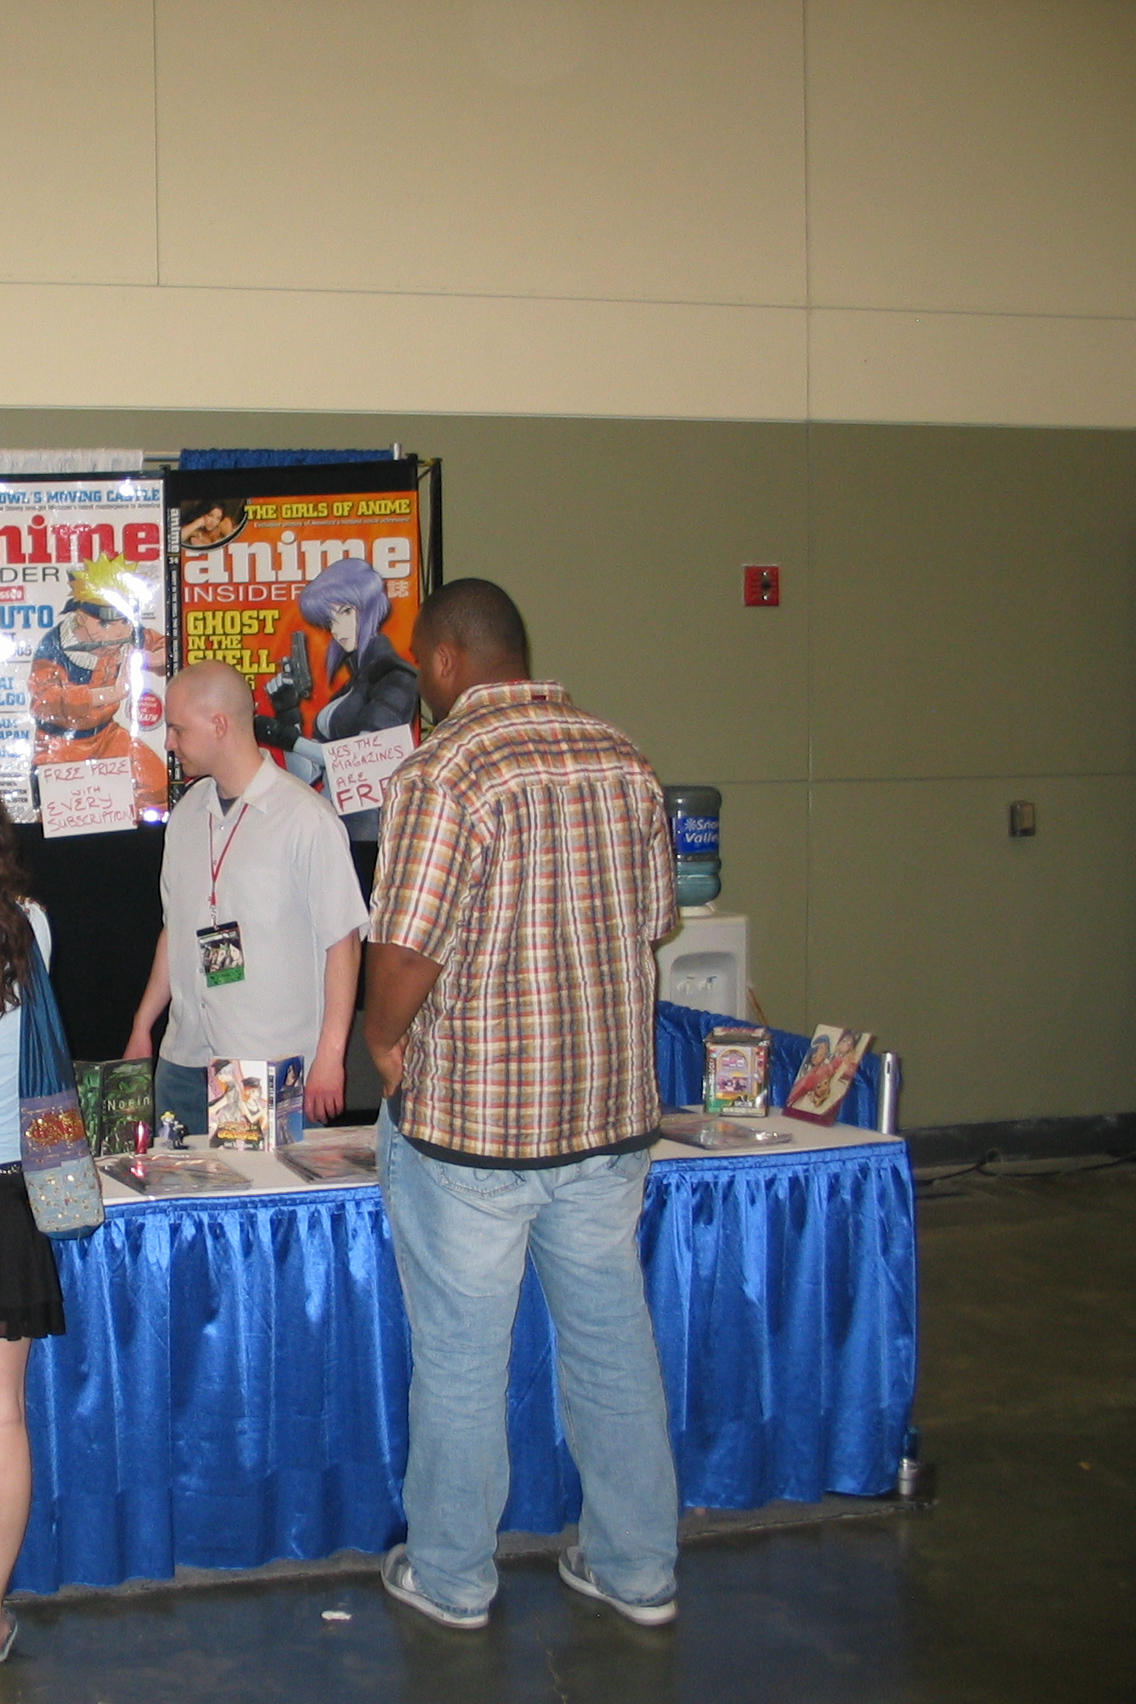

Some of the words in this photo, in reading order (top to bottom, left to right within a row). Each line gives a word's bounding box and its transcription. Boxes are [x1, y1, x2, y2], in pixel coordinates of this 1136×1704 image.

[47, 490, 102, 503] MOVING
[245, 504, 277, 520] THE
[281, 502, 328, 518] GIRLS
[332, 501, 352, 517] OF
[357, 498, 411, 515] ANIME
[184, 531, 411, 584] anime
[187, 609, 279, 635] GHOST
[187, 635, 206, 650] IN
[209, 635, 242, 650] THE
[354, 736, 382, 750] THE
[331, 745, 404, 773] MAGAZINES
[44, 767, 85, 784] FREE
[91, 760, 130, 777] PRIZE
[336, 771, 368, 789] ARE
[70, 786, 101, 796] WITH
[336, 777, 390, 812] FR
[46, 791, 113, 817] EVERY
